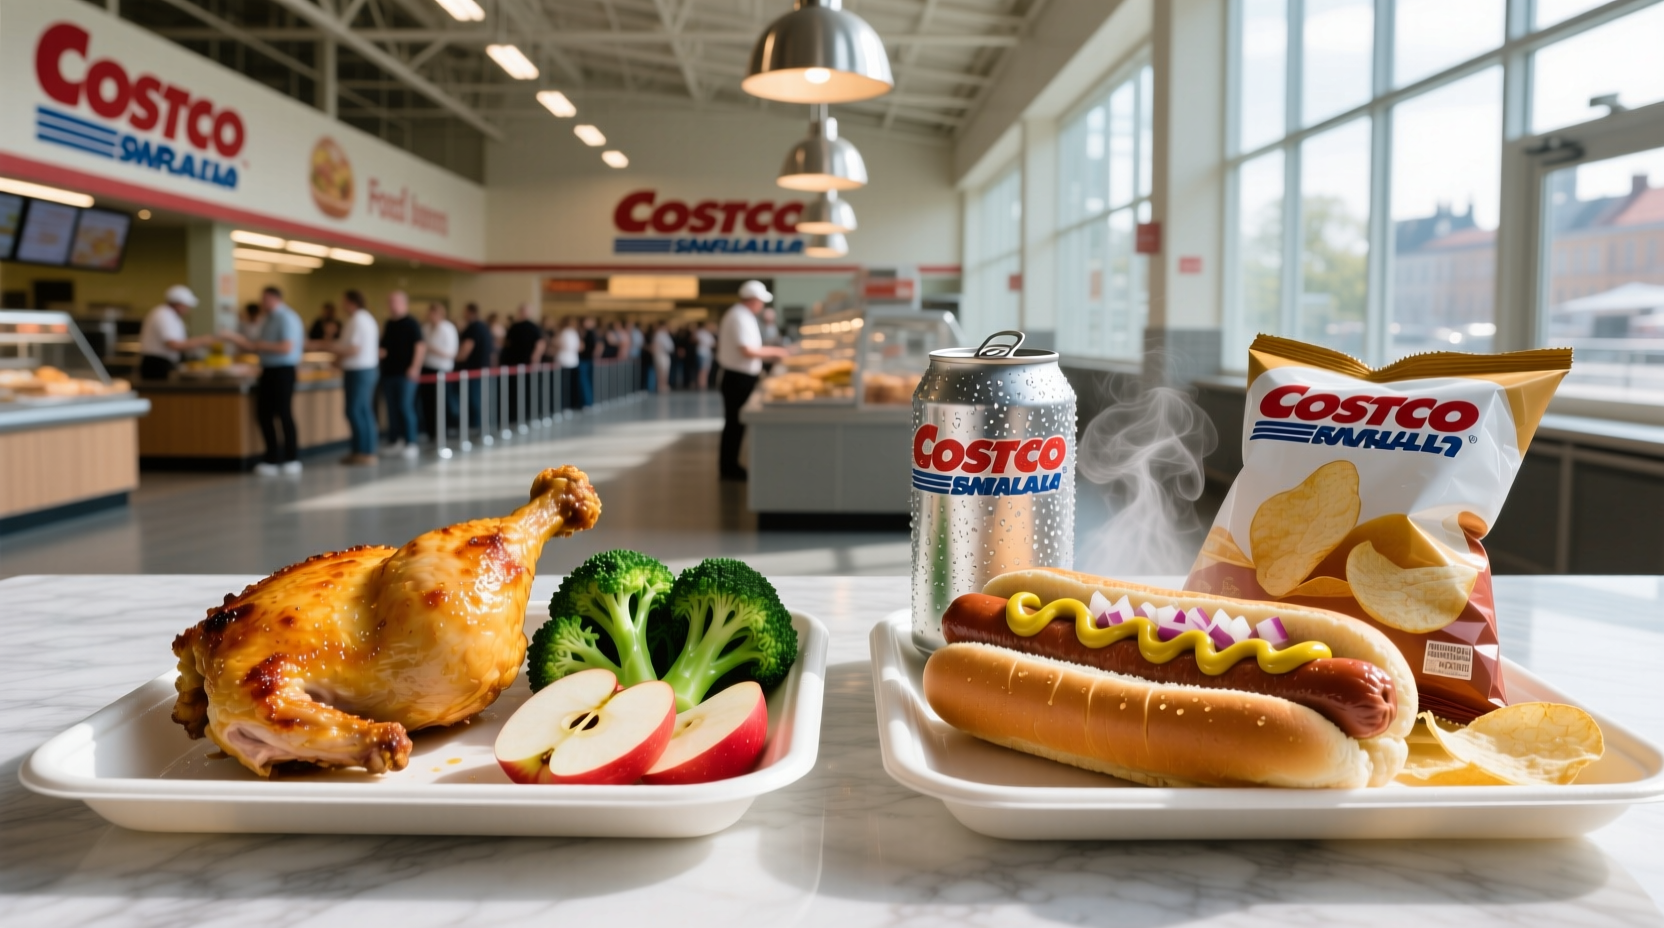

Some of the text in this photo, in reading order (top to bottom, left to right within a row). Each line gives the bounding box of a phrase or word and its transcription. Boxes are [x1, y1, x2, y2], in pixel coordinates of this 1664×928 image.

[34, 22, 246, 158] COSTCO
[614, 189, 804, 235] COSTCO
[1260, 384, 1480, 433] COSTCO
[913, 423, 1066, 474] COSTCO
